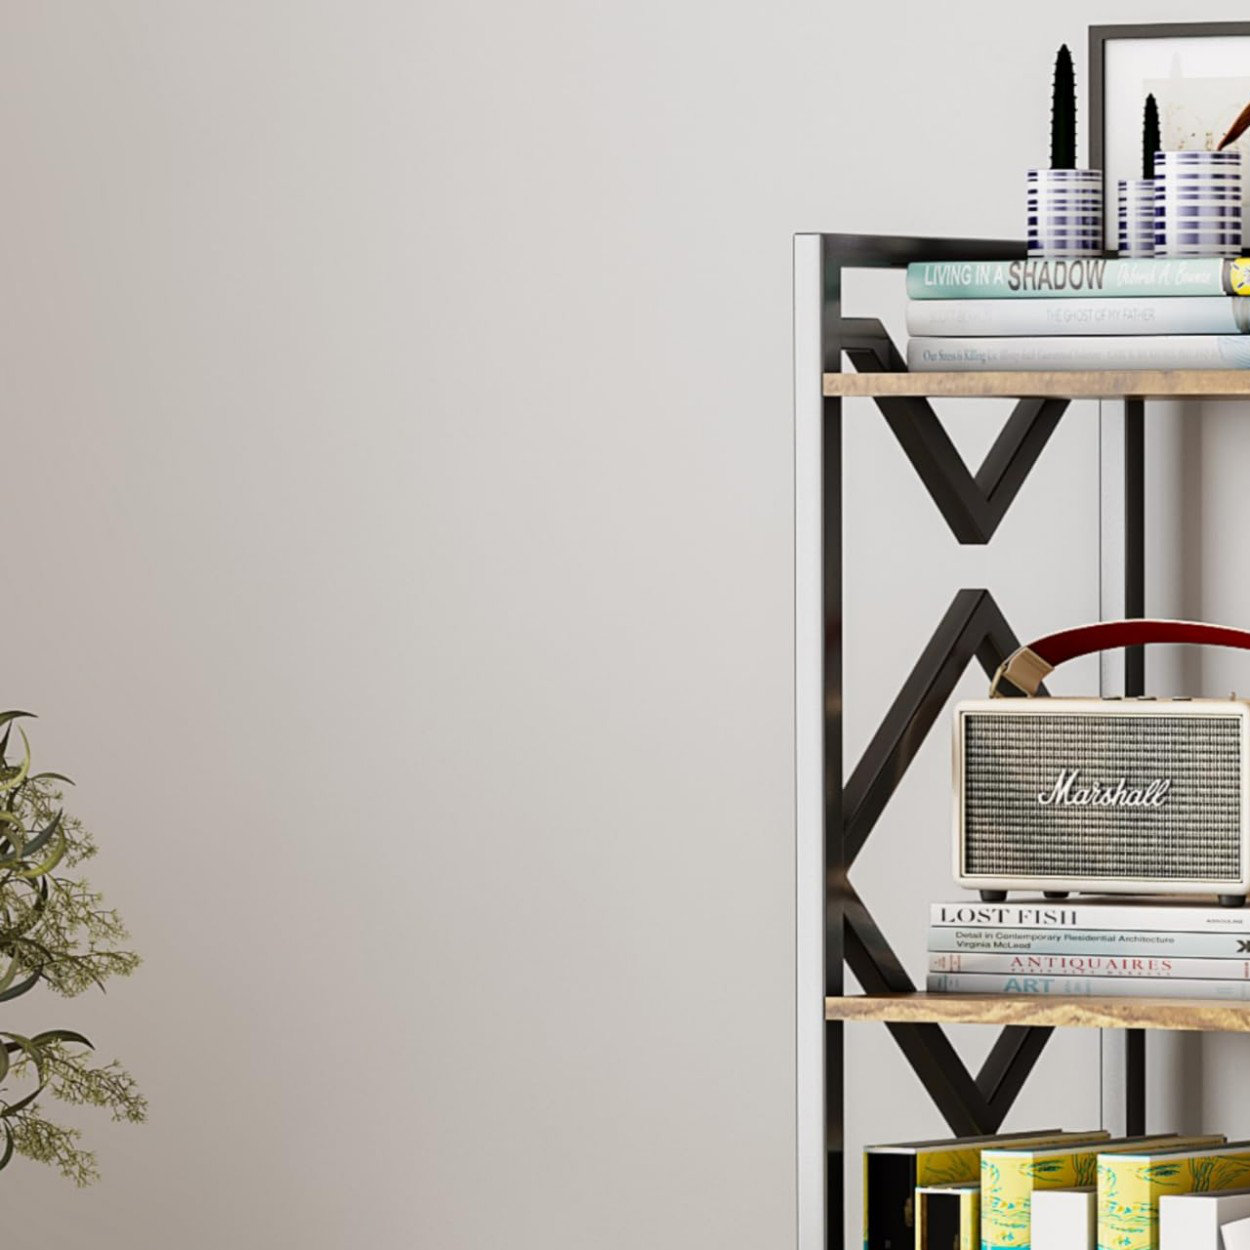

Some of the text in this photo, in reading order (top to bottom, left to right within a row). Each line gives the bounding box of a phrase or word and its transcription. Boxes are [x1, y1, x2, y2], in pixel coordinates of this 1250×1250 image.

[925, 264, 971, 286] LIVING
[975, 264, 990, 285] IN
[993, 263, 1003, 284] A
[1008, 260, 1106, 291] SHADOW
[1064, 308, 1092, 322] GHOST
[1122, 308, 1155, 321] FATHER
[1038, 768, 1171, 807] Marshall
[941, 908, 1076, 925] LOST FISH
[955, 931, 982, 939] Detail
[996, 932, 1061, 942] Contemporary
[1064, 933, 1115, 942] Residential
[1118, 935, 1175, 943] Architecture
[956, 941, 1031, 949] Virginia McLeod
[1010, 956, 1173, 971] ANTIQUAIRES
[1004, 978, 1055, 992] ART
